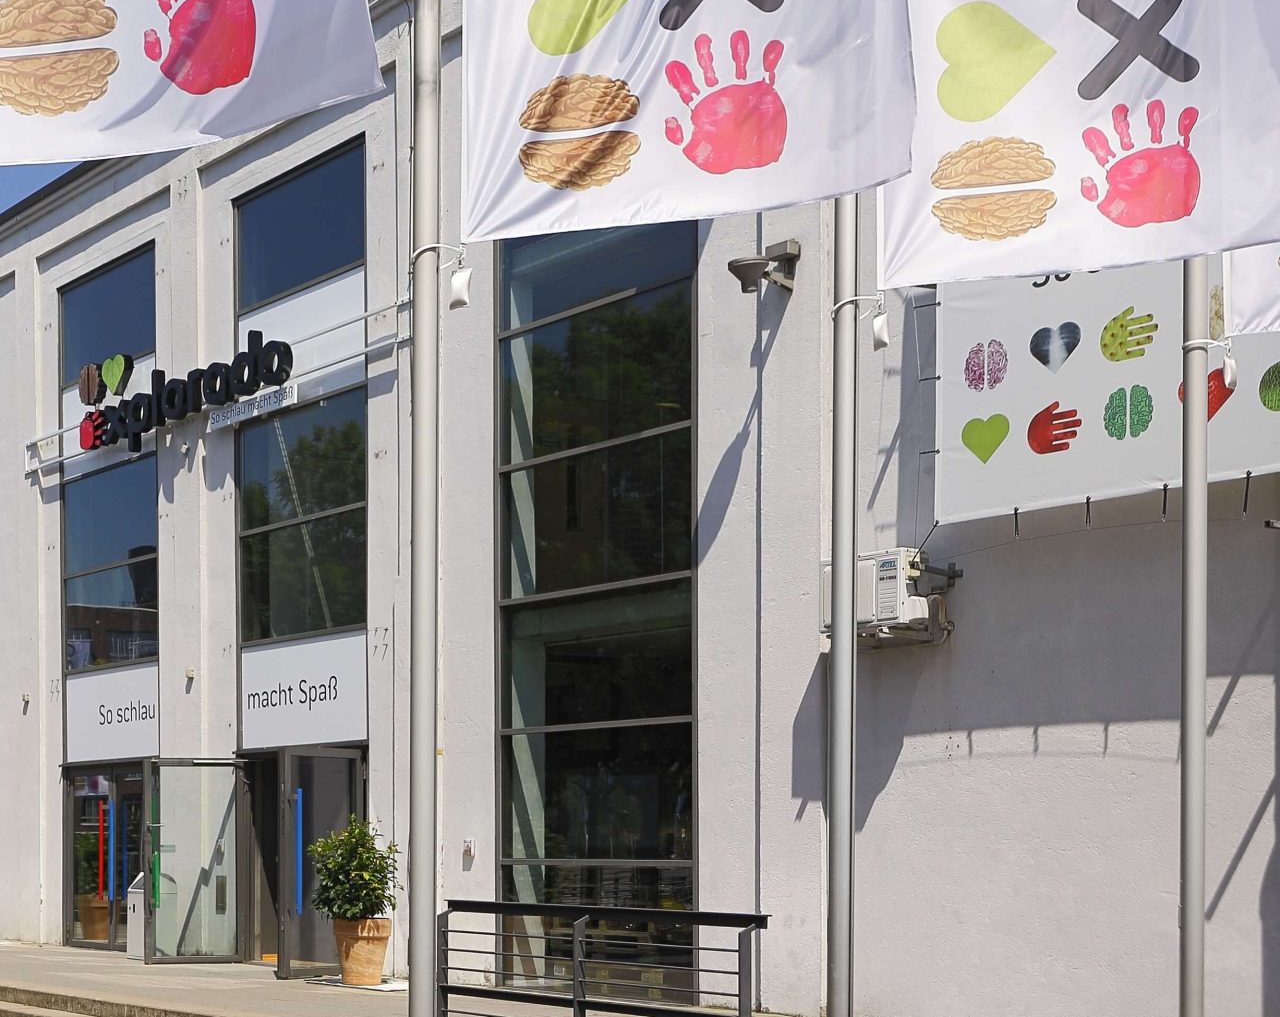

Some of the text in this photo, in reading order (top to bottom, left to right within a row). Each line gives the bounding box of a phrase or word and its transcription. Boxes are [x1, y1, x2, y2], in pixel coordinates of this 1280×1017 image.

[102, 329, 294, 453] xplorado
[210, 385, 294, 425] So schlau macht Spaß
[98, 699, 156, 726] So schlau
[247, 675, 339, 712] macht Spaß
